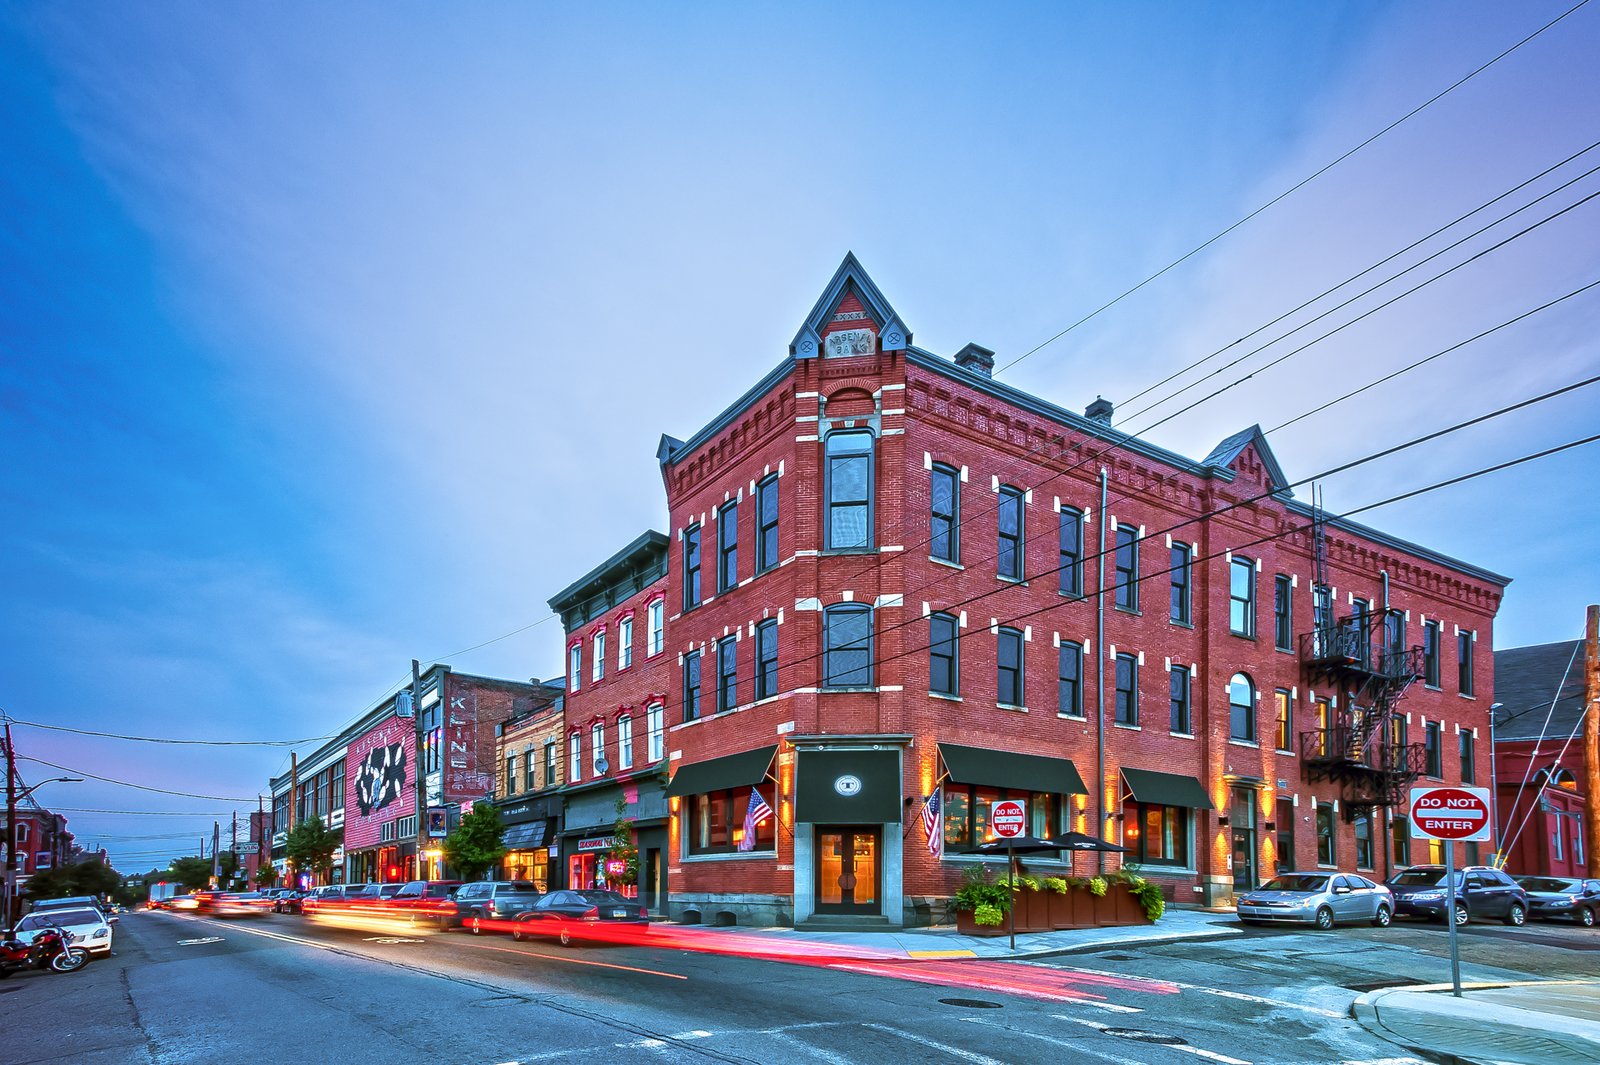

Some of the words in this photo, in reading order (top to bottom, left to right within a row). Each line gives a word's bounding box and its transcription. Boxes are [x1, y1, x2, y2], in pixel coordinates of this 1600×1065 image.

[829, 332, 871, 346] ARSENAL
[836, 343, 867, 355] BANK
[1420, 798, 1441, 807] DO
[1447, 798, 1478, 807] NOT
[998, 824, 1019, 832] ENTER
[1425, 820, 1473, 830] ENTER
